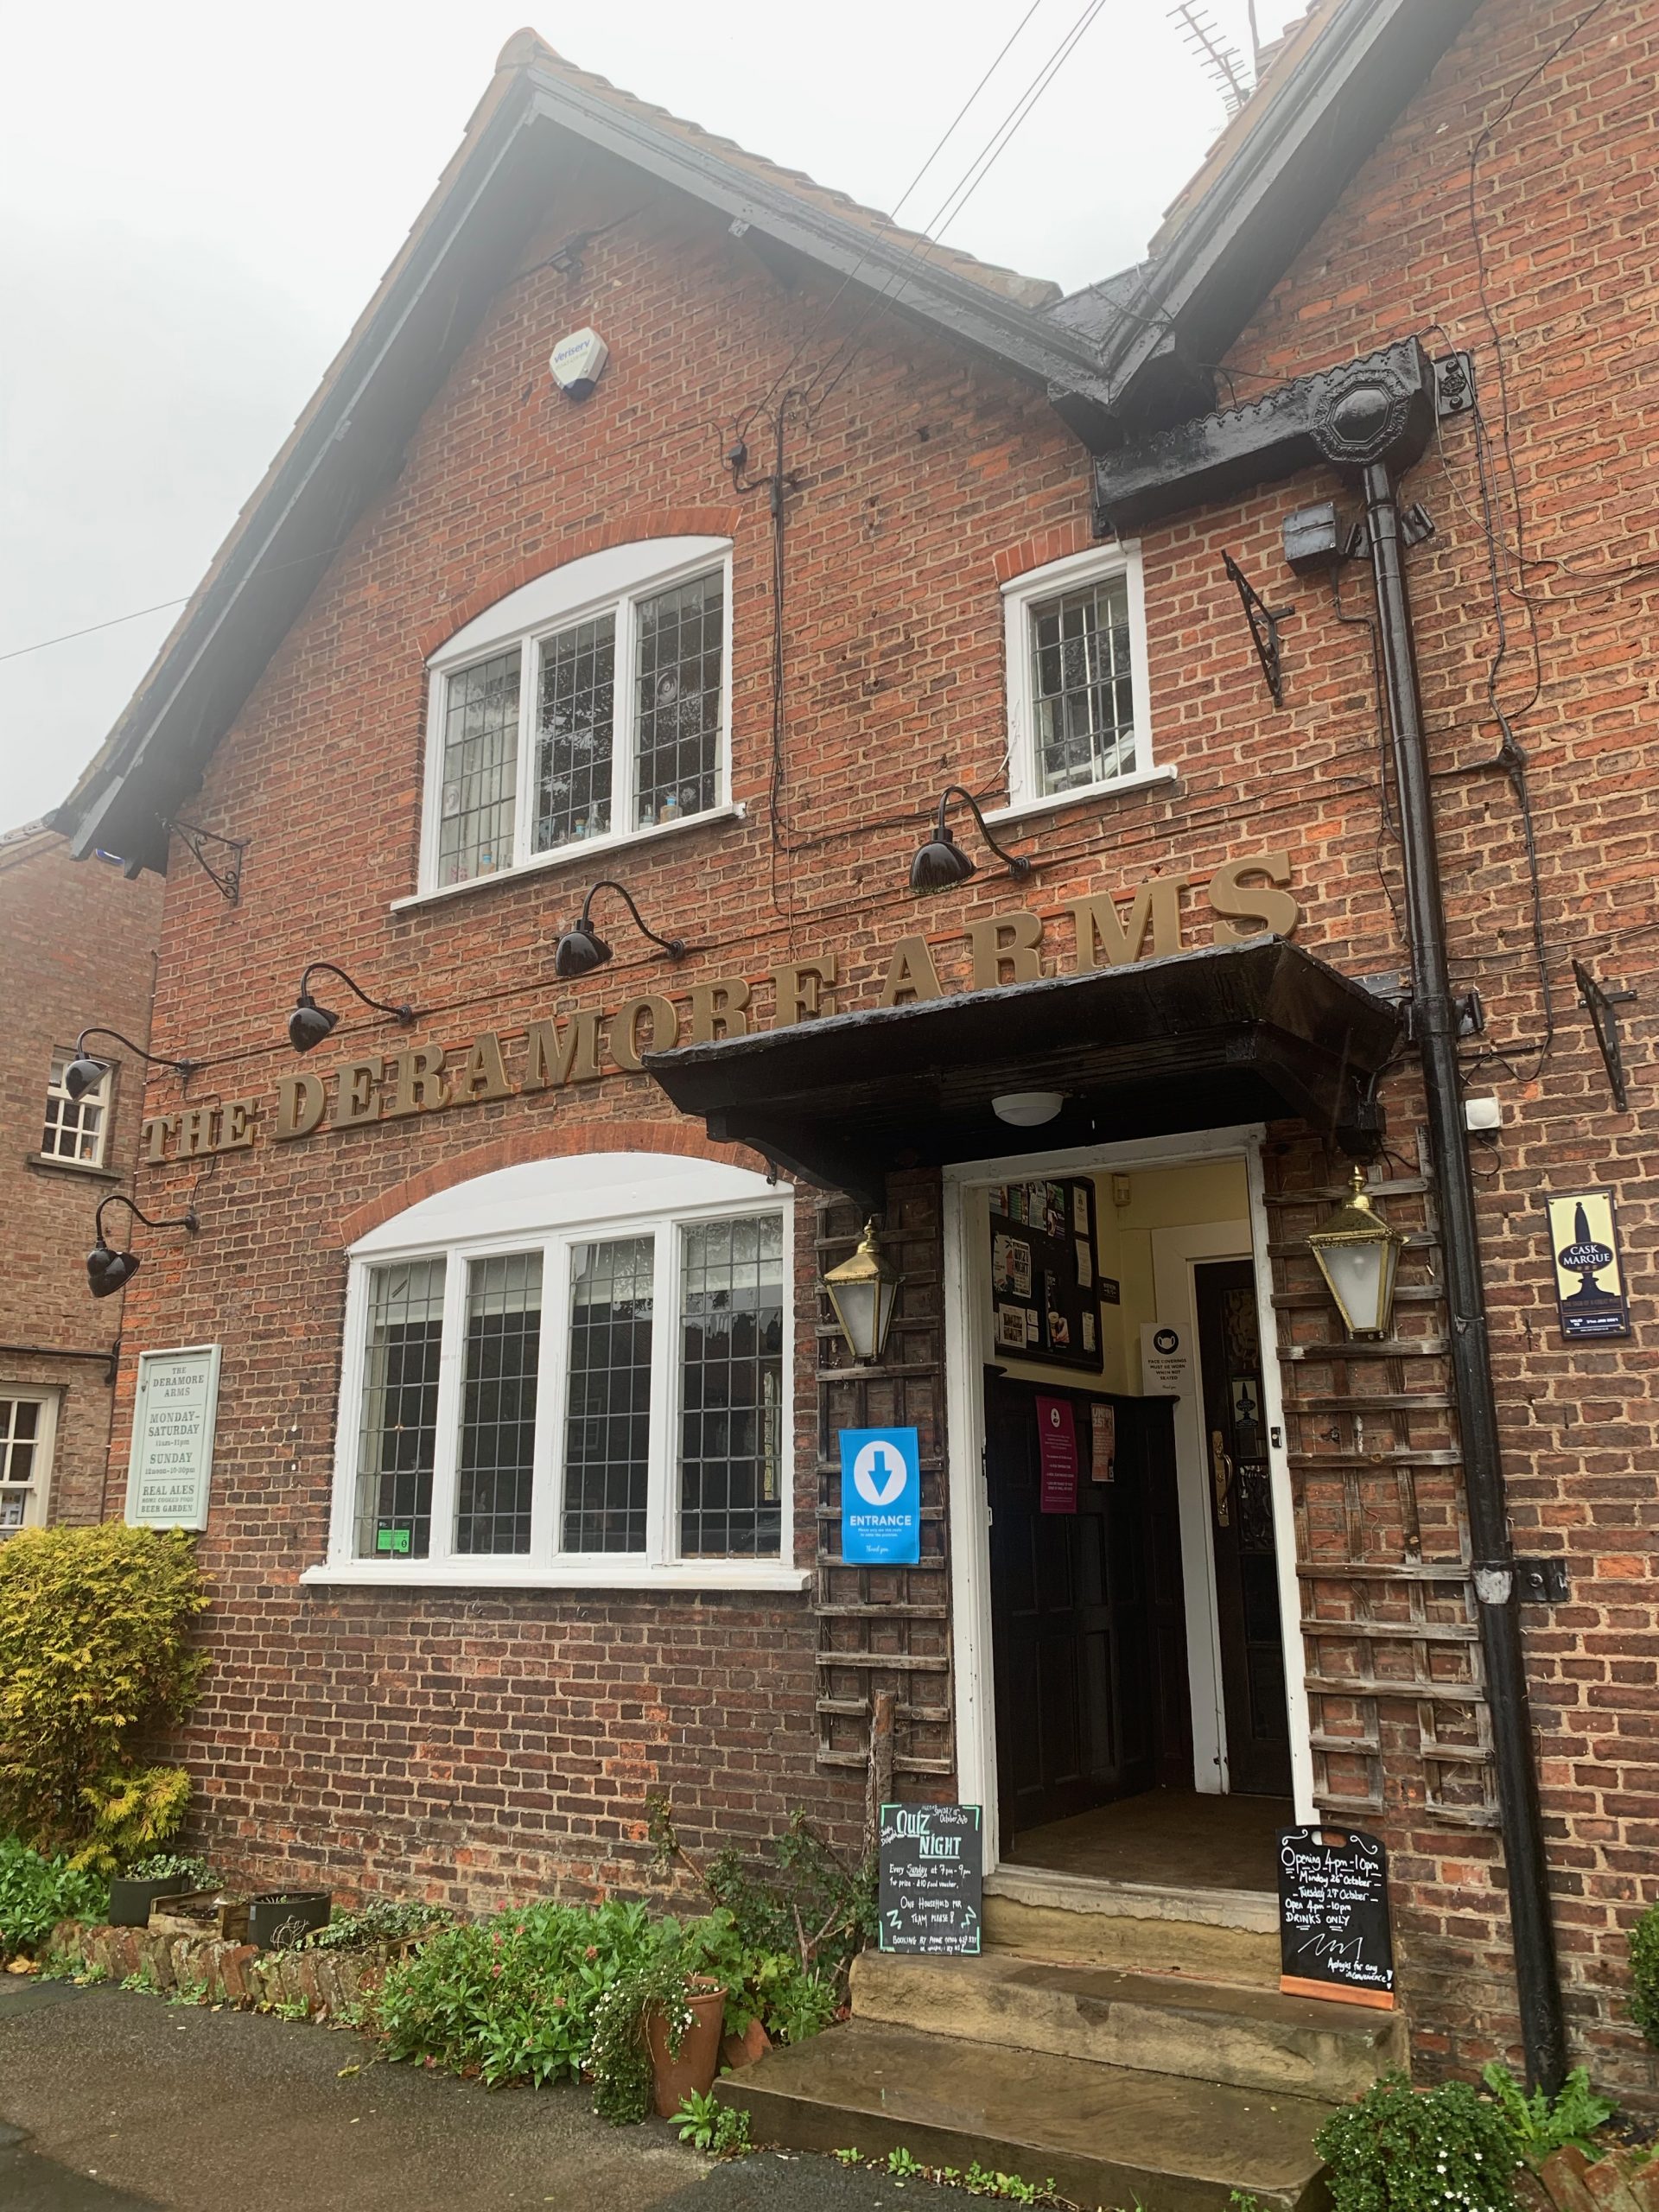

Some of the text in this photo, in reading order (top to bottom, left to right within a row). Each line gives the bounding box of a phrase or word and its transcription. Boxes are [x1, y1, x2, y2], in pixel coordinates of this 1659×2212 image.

[142, 851, 1300, 1166] THE DERAMORE ARMS
[1569, 1244, 1599, 1255] CASK
[1562, 1253, 1611, 1265] MARQUE
[153, 1375, 205, 1387] DERAMORE
[164, 1387, 191, 1397] ARMS
[148, 1424, 200, 1436] SATURDAY
[149, 1452, 193, 1464] SUNDAY
[143, 1484, 194, 1496] REAL ALES
[849, 1515, 912, 1527] ENTRANCE
[918, 1833, 962, 1856] NIGHT
[1281, 1847, 1321, 1874] Opening
[889, 1864, 905, 1876] Every
[906, 1864, 927, 1878] Sunday
[931, 1865, 938, 1874] at
[1344, 1875, 1372, 1888] October
[1298, 1885, 1325, 1903] Tuesday
[1339, 1889, 1370, 1901] October
[1285, 1897, 1303, 1913] Open
[911, 1913, 928, 1929] TEAM
[1285, 1911, 1351, 1926] DRINKS ONLY
[893, 1936, 917, 1946] BOOKING
[1353, 1960, 1363, 1971] for
[1365, 1964, 1378, 1975] any
